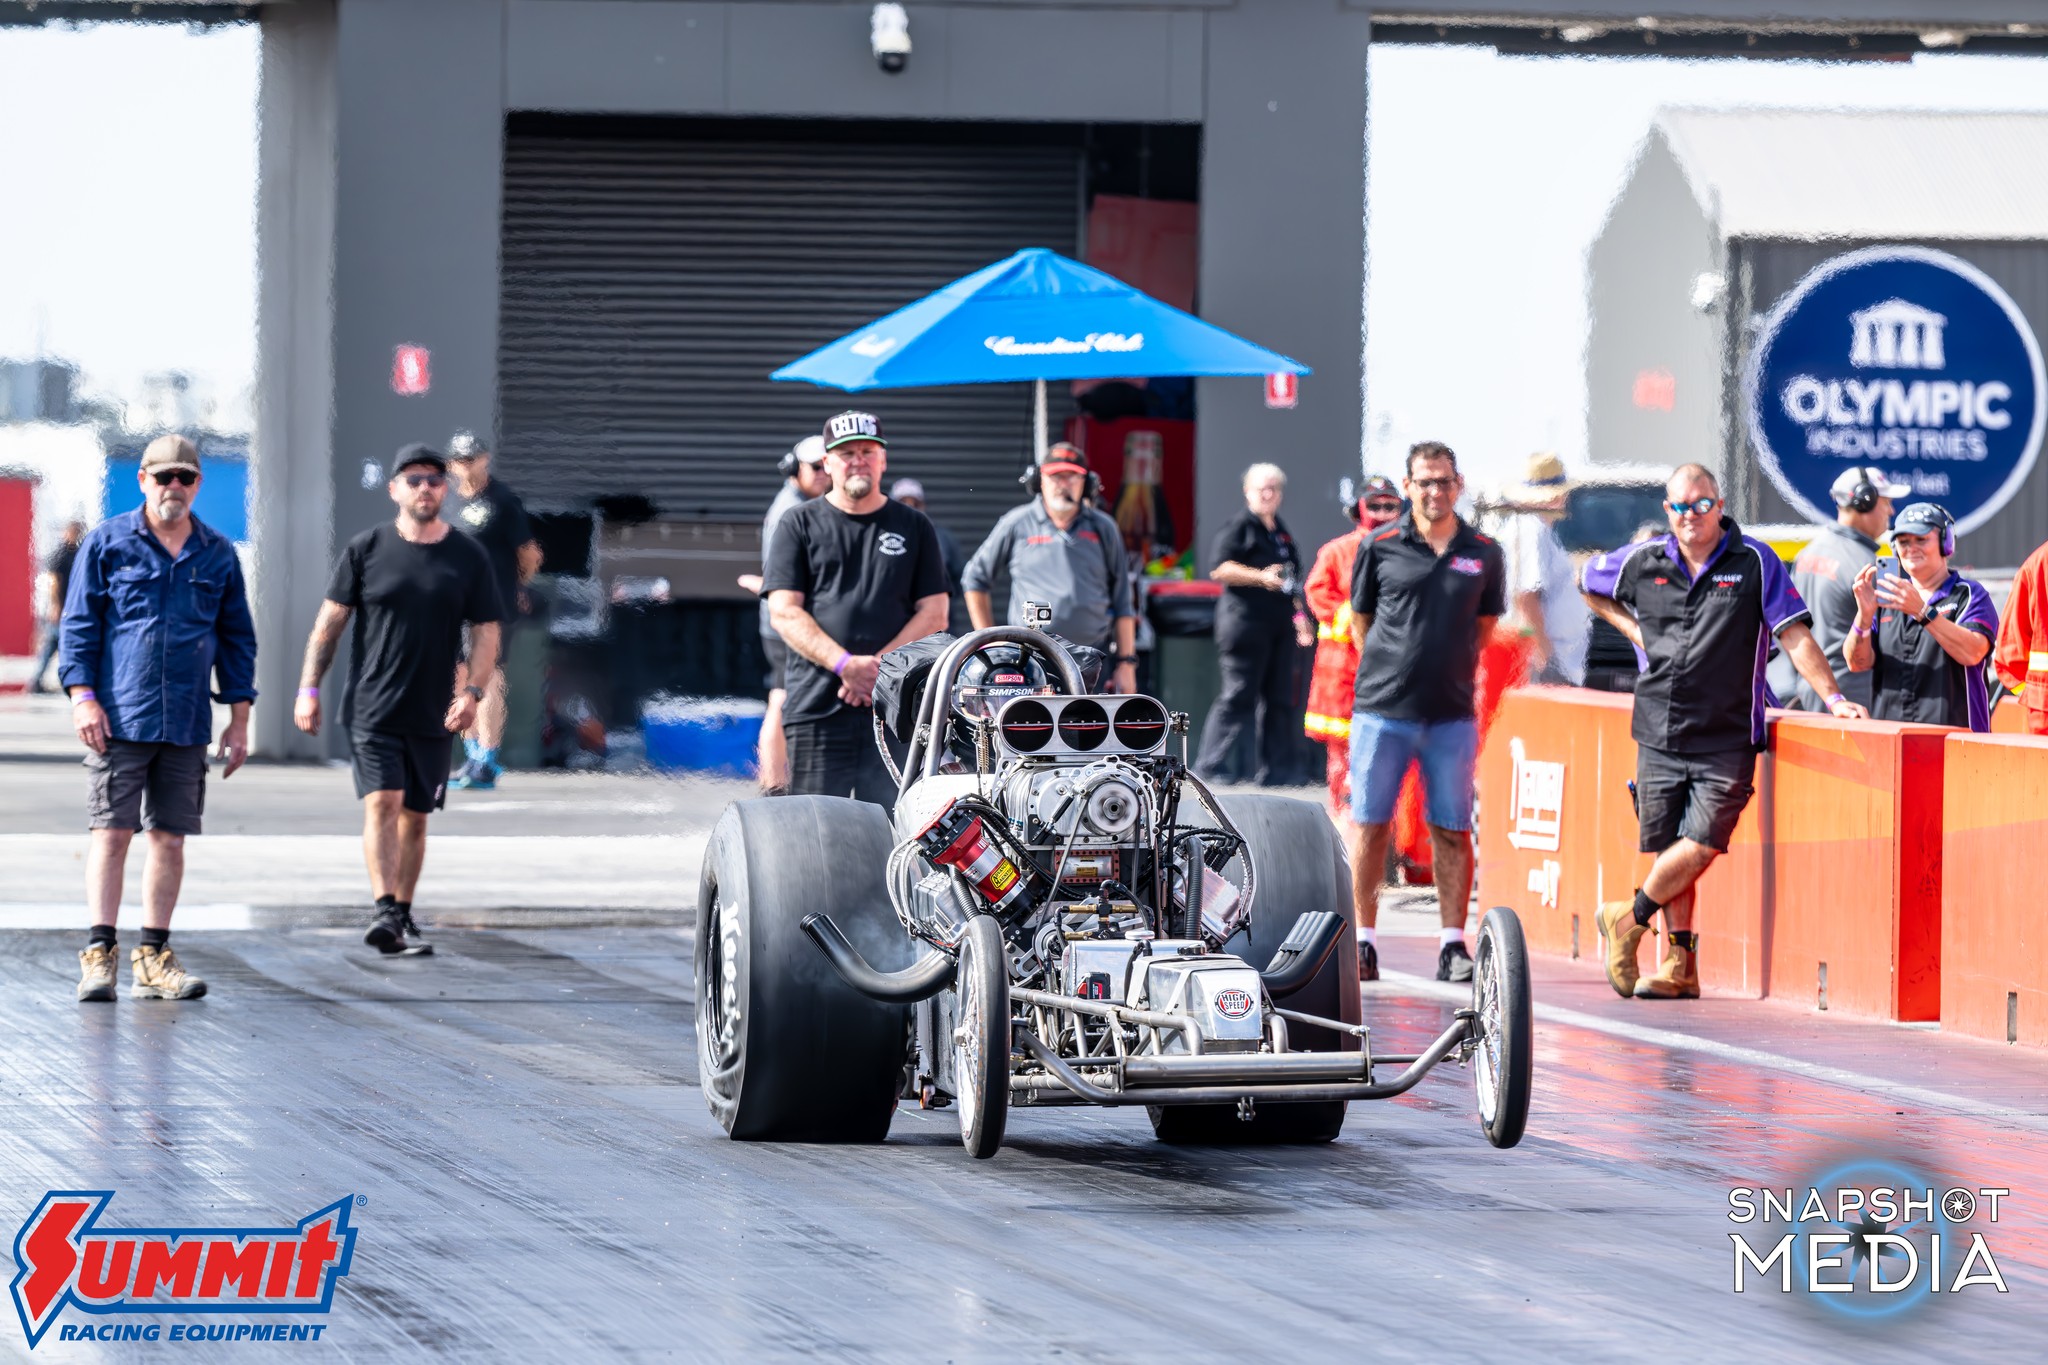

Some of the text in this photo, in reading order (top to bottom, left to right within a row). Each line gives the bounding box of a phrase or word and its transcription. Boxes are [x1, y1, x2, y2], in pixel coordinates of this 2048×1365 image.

[1780, 373, 2012, 430] OLYMPIC
[830, 413, 877, 438] CELTICS
[1806, 427, 1988, 460] INDUSTRIES
[988, 688, 1034, 696] SIMPSON
[1221, 993, 1246, 1001] HIGH
[1224, 1001, 1245, 1010] SPEED
